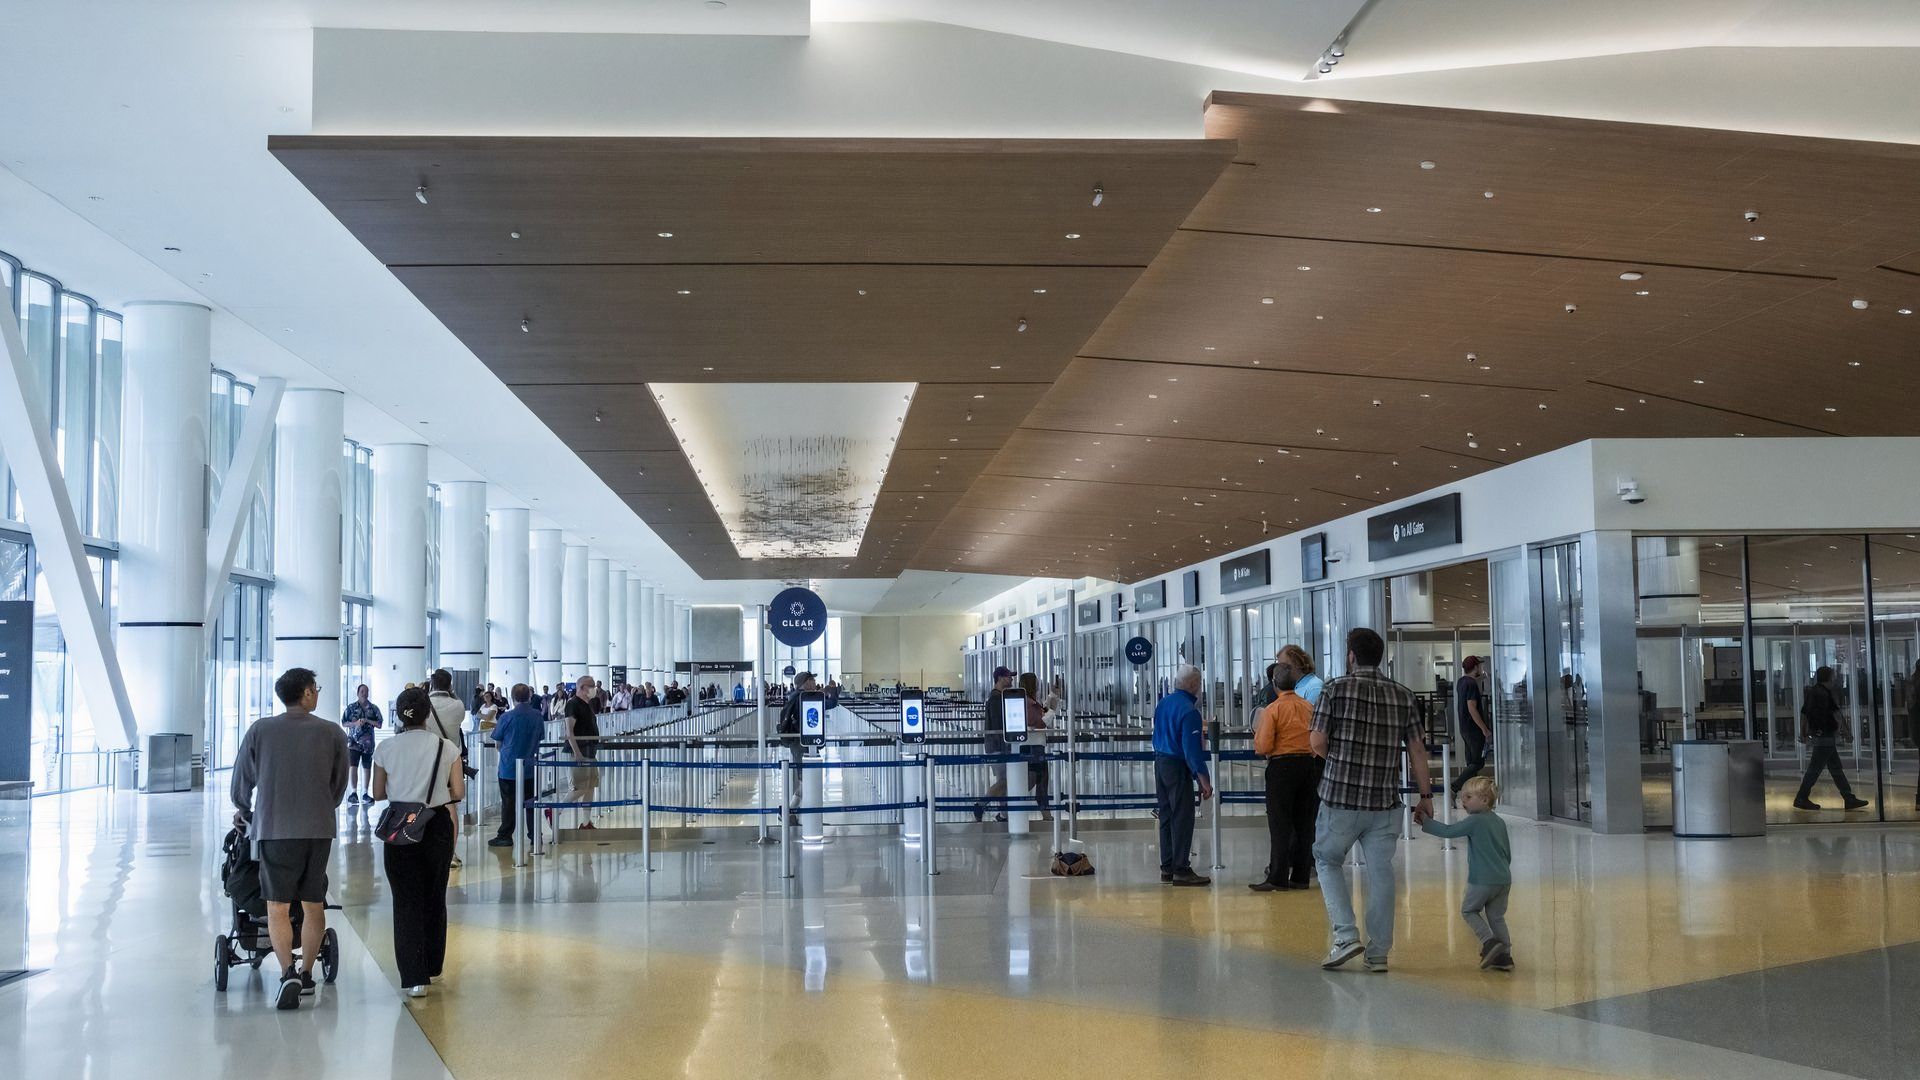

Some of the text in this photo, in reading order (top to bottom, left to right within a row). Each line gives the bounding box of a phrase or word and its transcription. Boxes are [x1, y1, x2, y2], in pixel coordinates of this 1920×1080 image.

[1400, 525, 1406, 537] To
[1413, 522, 1424, 535] Gates
[782, 619, 814, 627] CLEAR
